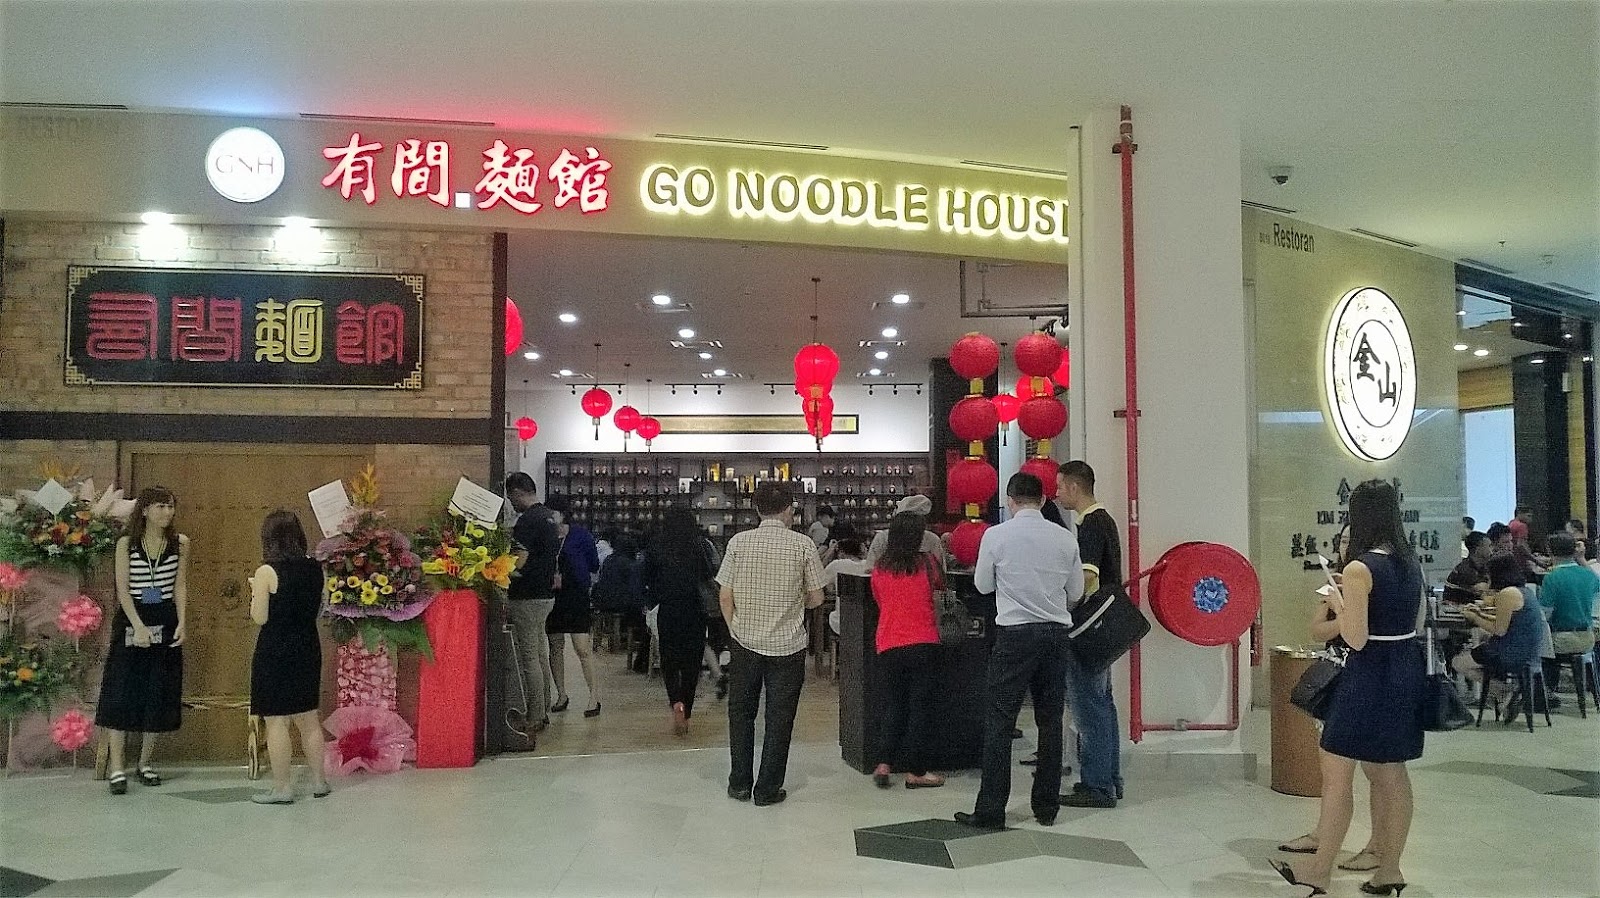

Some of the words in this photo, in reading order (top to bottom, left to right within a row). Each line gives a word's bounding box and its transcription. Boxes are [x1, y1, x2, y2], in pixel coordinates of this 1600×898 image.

[215, 154, 275, 175] GNH
[647, 166, 716, 208] GO
[734, 171, 929, 223] NOODLE
[1273, 222, 1315, 253] Restoran
